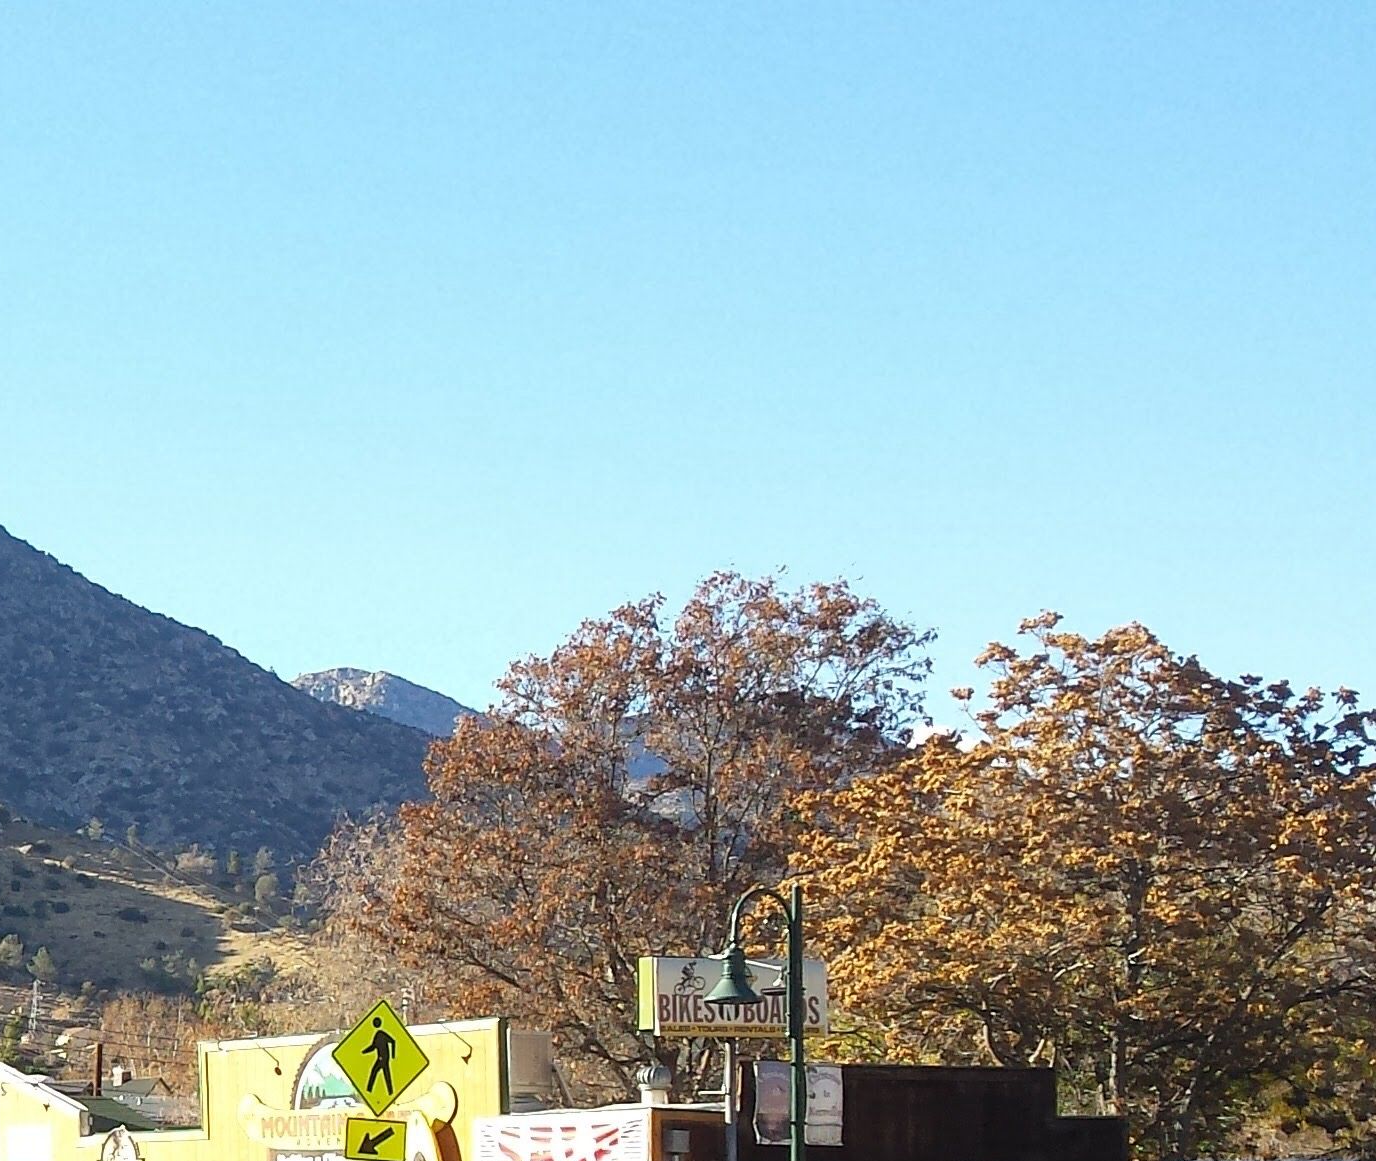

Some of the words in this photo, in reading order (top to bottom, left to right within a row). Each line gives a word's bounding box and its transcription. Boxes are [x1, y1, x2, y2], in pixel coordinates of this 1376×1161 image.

[659, 993, 716, 1024] BIKES
[743, 994, 821, 1025] BOAS
[697, 1025, 729, 1033] TOURS
[734, 1025, 776, 1034] RENTALS
